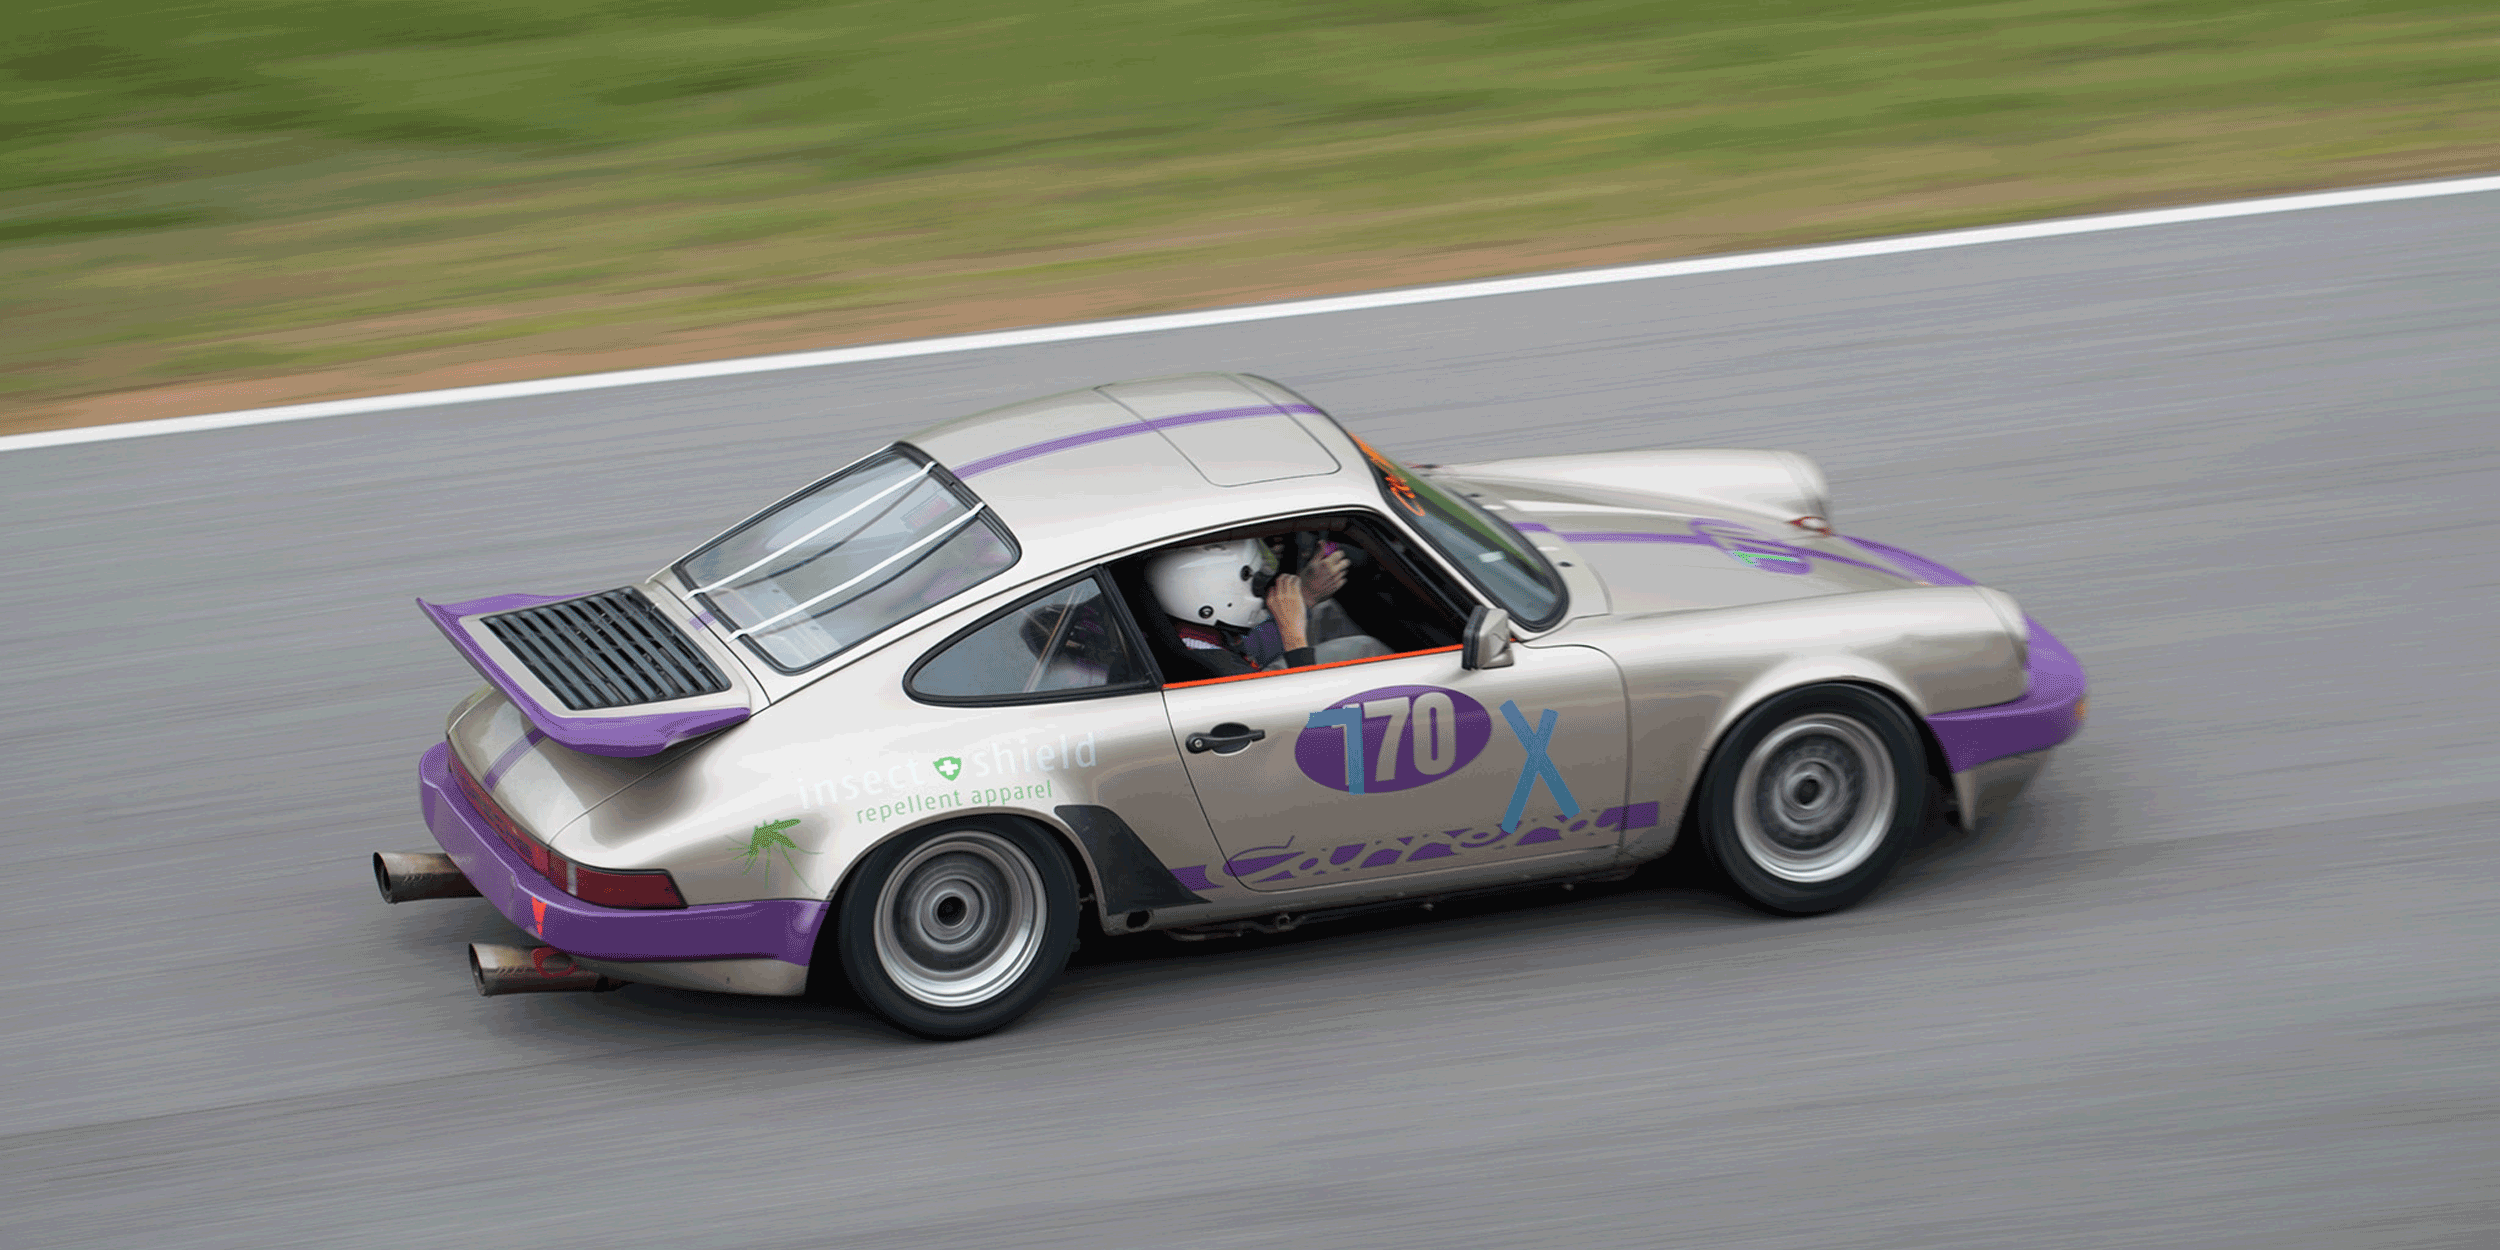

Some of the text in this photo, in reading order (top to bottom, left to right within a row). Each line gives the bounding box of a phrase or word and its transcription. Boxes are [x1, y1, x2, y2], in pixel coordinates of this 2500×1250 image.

[798, 730, 1097, 809] insect shield
[856, 780, 1053, 824] repellent apparel
[1499, 699, 1581, 834] X
